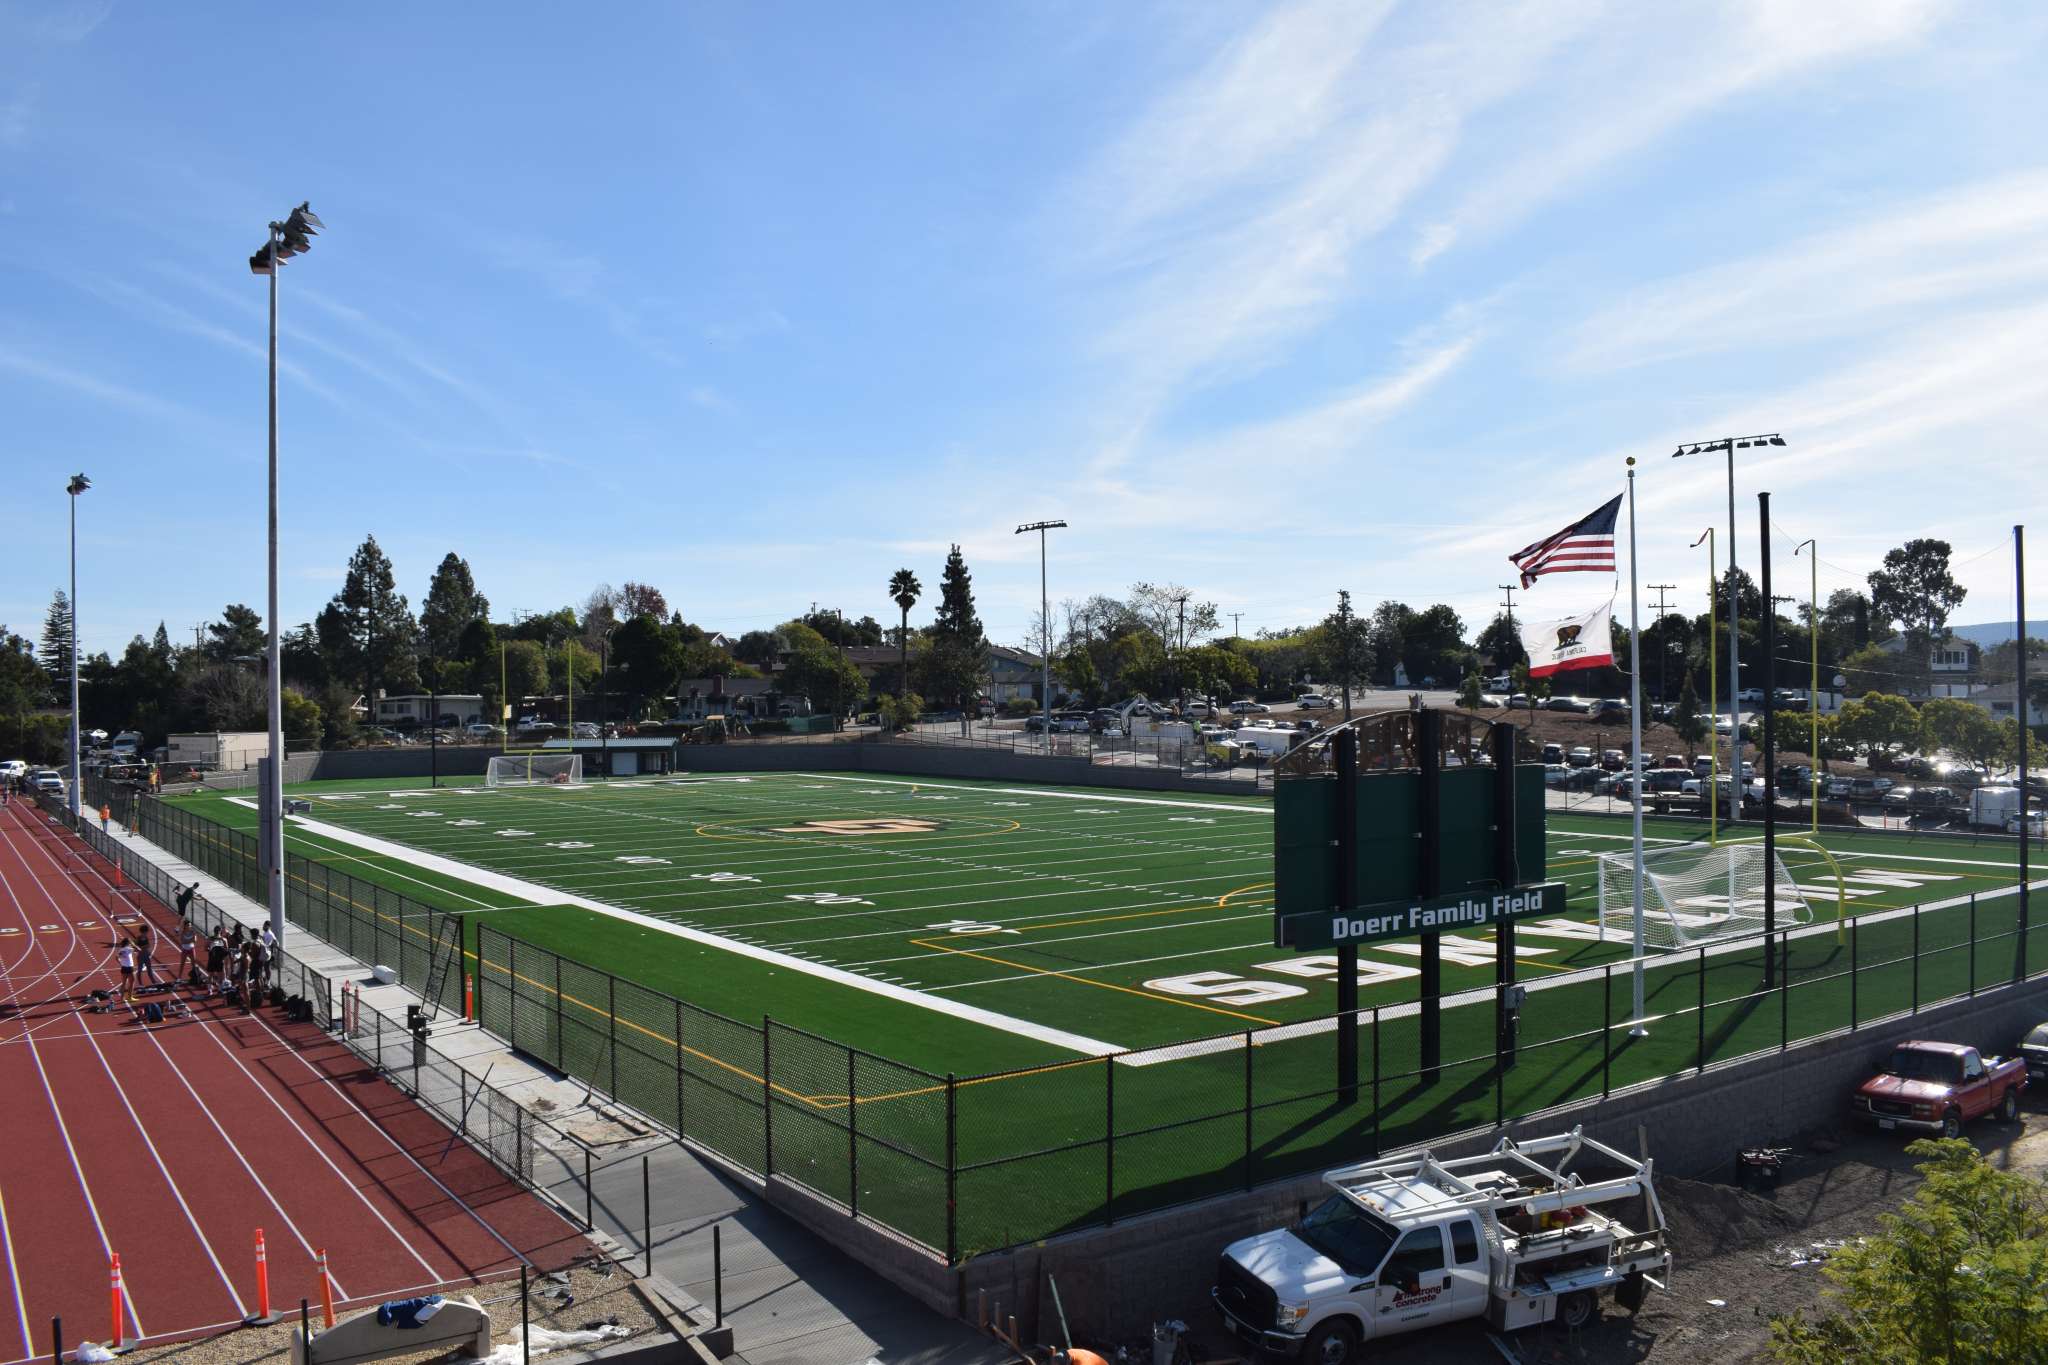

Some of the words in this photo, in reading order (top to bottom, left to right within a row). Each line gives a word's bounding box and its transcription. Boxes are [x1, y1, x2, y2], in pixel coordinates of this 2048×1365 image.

[784, 892, 864, 904] 20
[1332, 913, 1404, 940] Doerr
[1409, 900, 1487, 924] Family
[1492, 890, 1543, 916] Field
[926, 919, 1002, 934] 10
